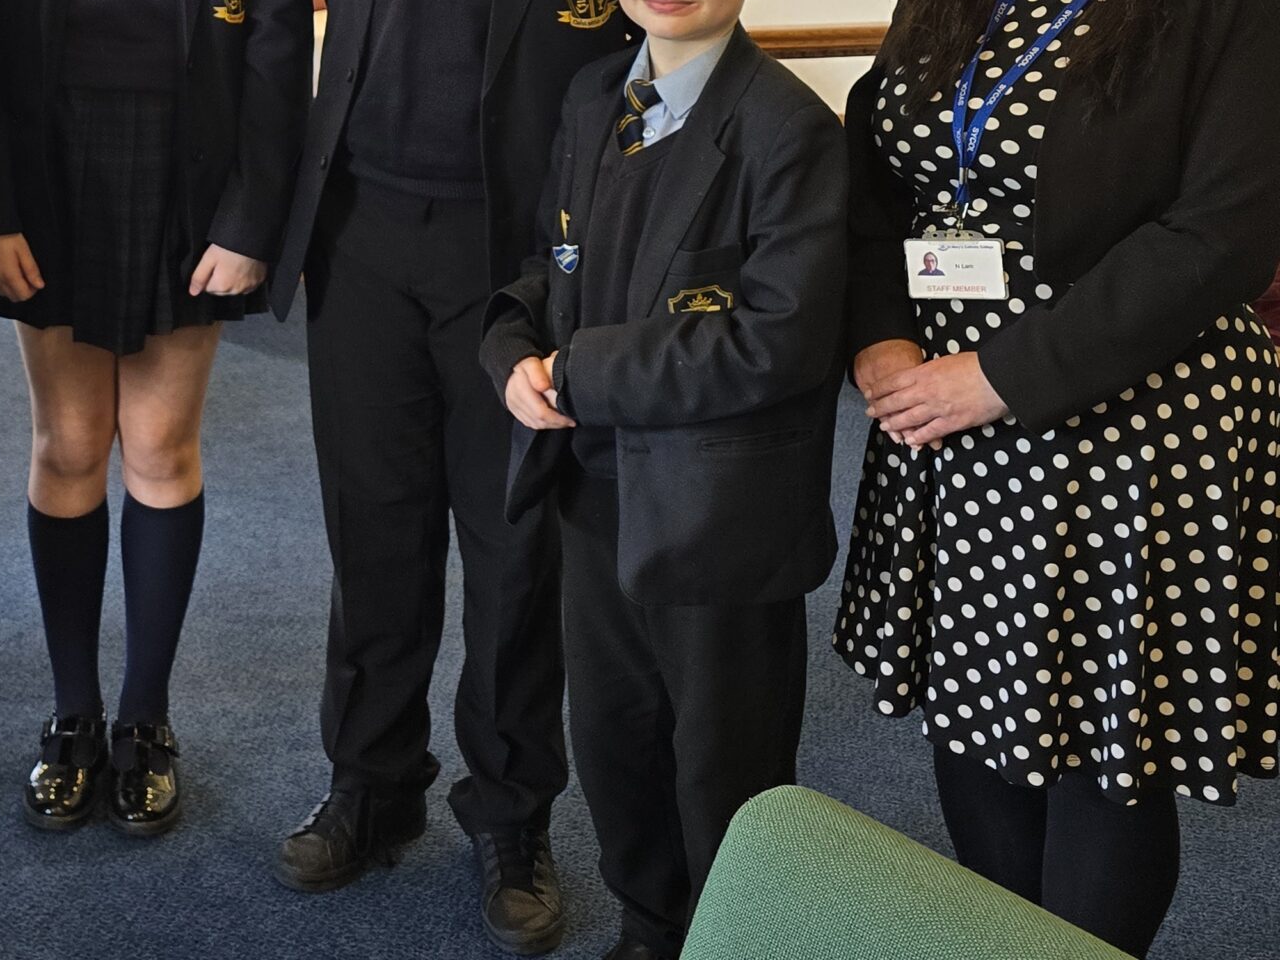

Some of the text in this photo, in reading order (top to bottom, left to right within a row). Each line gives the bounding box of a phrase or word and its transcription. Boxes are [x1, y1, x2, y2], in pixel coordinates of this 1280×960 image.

[1051, 9, 1073, 30] SYCOL
[1017, 46, 1040, 68] SYCOL
[986, 83, 1007, 106] SYCOL
[966, 126, 980, 152] SYCOL
